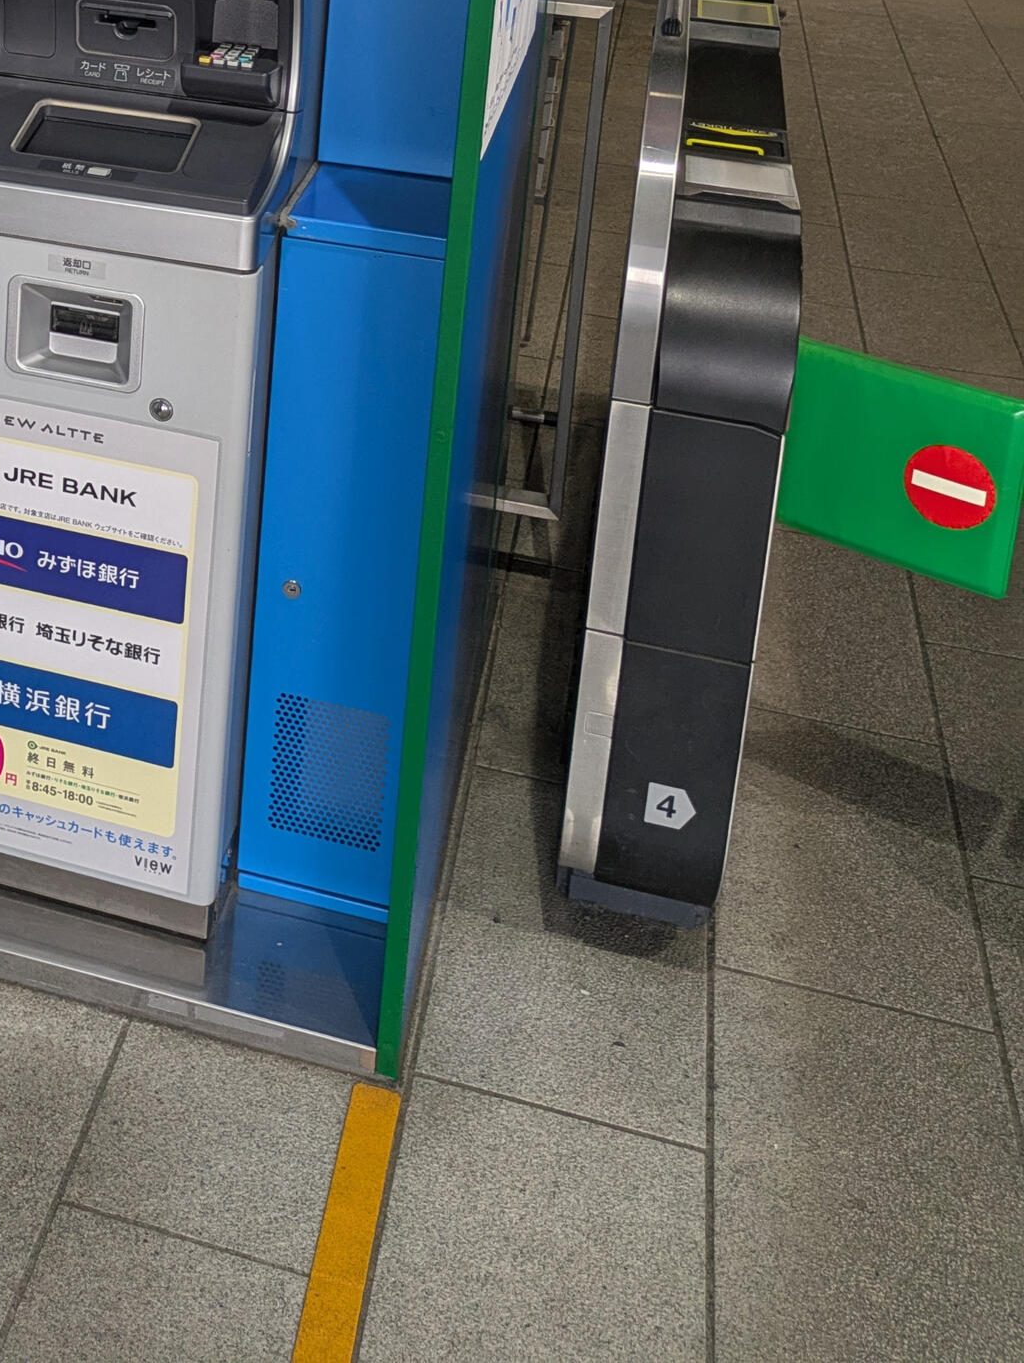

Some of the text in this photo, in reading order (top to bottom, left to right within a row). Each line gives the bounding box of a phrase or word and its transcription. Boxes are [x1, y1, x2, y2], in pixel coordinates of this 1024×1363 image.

[80, 60, 106, 71] カード
[136, 68, 171, 80] レシート
[140, 78, 165, 86] RECEIPT
[62, 257, 91, 270] 返却口
[41, 423, 105, 444] ALTTE
[4, 467, 137, 508] JRE BANK
[37, 550, 140, 589] みずほ銀行
[36, 621, 161, 665] 埼玉りそな銀行
[5, 772, 18, 786] 円
[656, 796, 677, 820] 4
